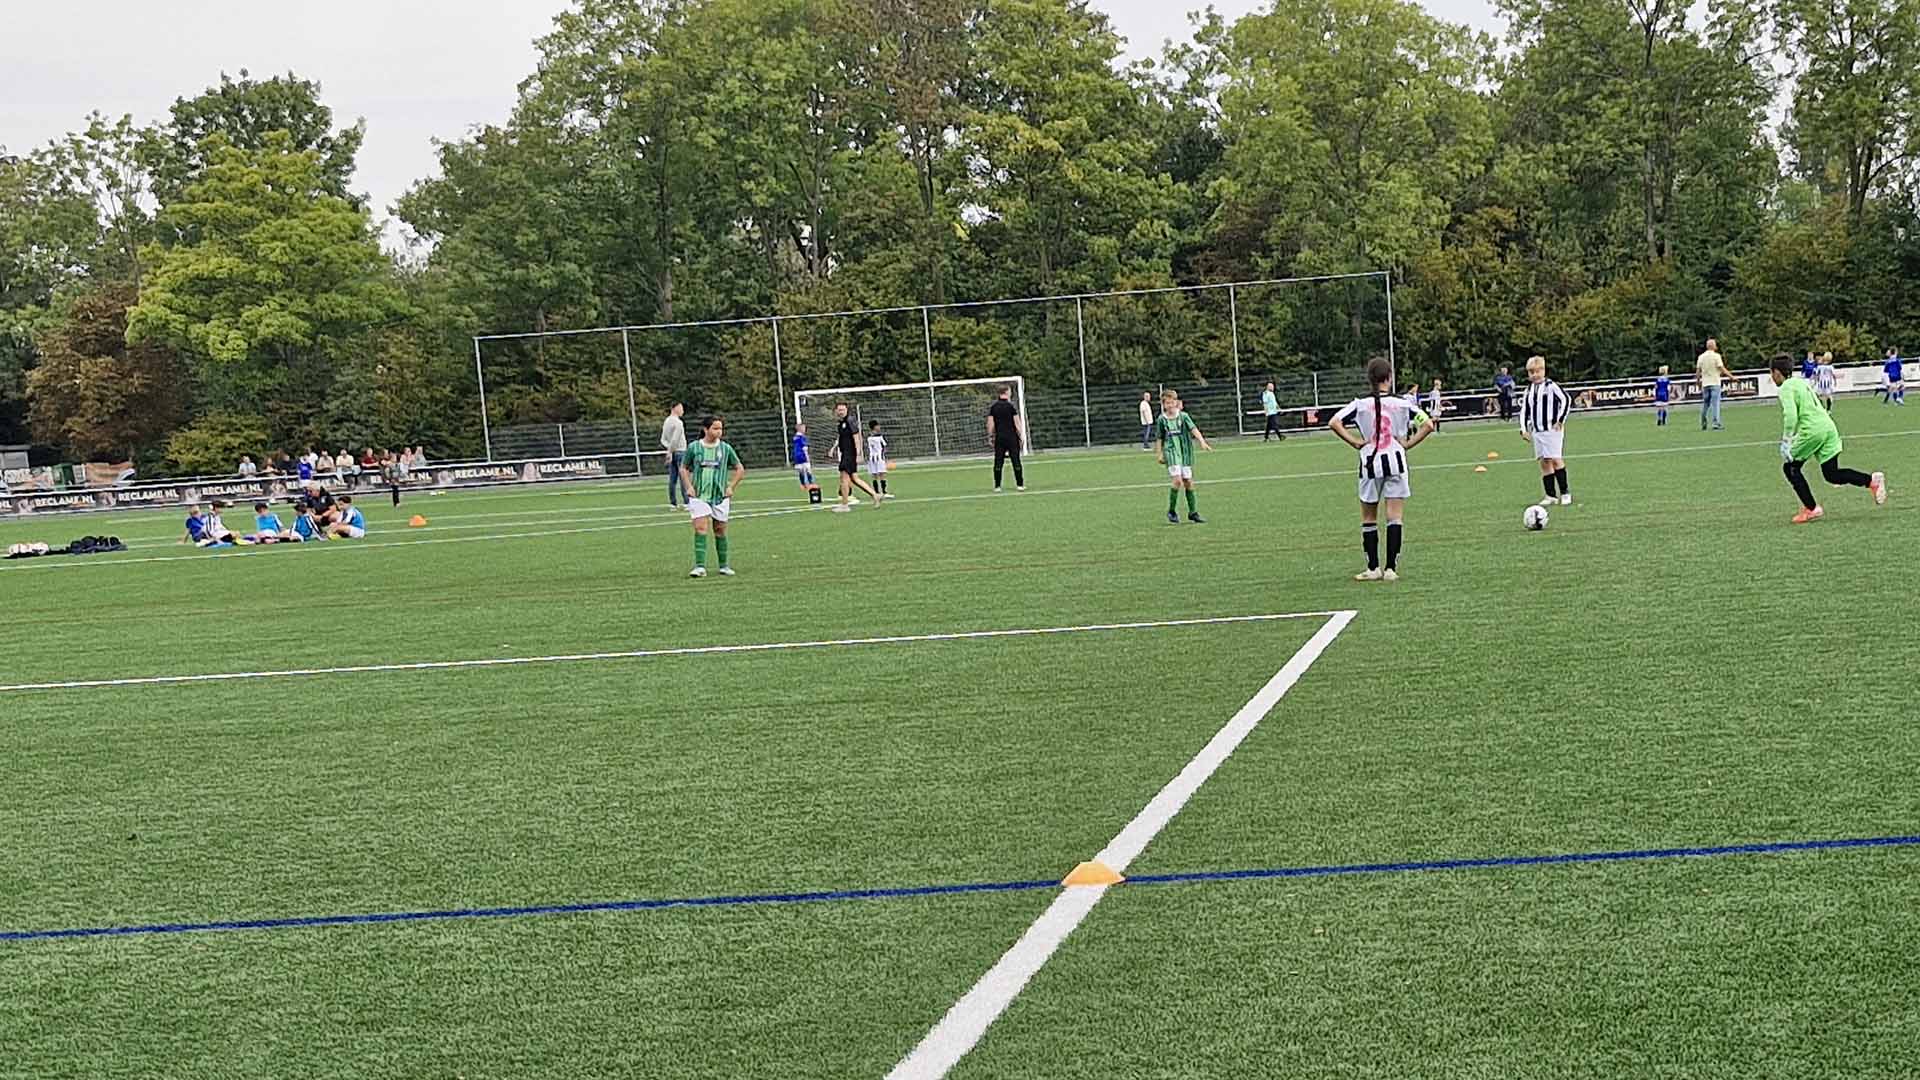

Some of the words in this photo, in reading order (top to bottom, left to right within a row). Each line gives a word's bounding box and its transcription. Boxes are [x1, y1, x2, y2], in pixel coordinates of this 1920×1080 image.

[1596, 388, 1656, 401] RECLAME.N
[454, 466, 517, 479] RECLAME.NL
[540, 460, 602, 473] RECLAME.NL
[118, 488, 180, 502] RECLAME.NL
[202, 482, 264, 496] RECLAME.NL
[34, 494, 96, 508] RECLAME.NL
